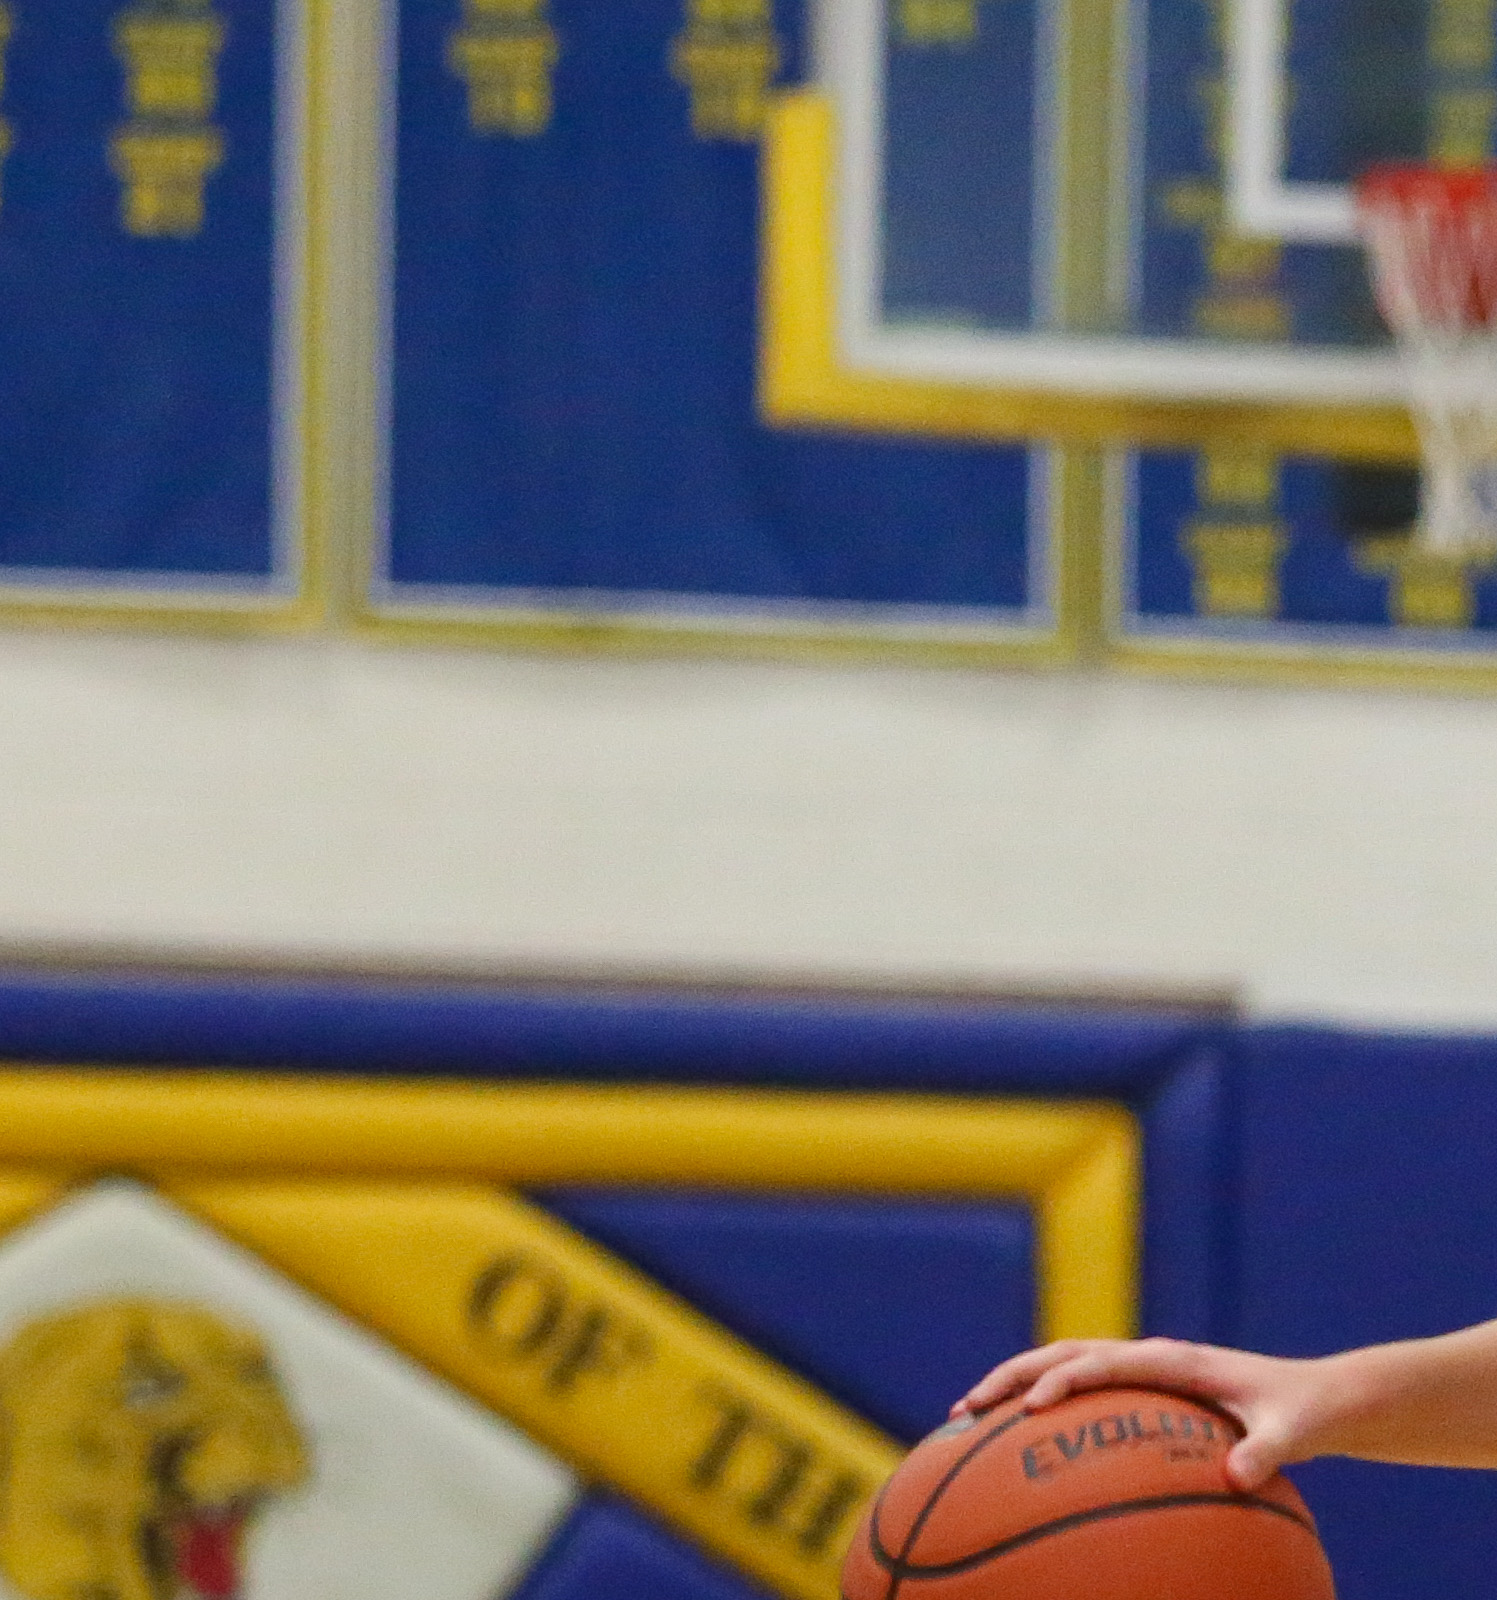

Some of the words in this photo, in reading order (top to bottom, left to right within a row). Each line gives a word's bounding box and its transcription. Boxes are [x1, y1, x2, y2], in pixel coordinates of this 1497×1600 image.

[466, 1248, 656, 1396] OF
[688, 1376, 866, 1560] TH
[1021, 1410, 1220, 1480] EVOLUT
